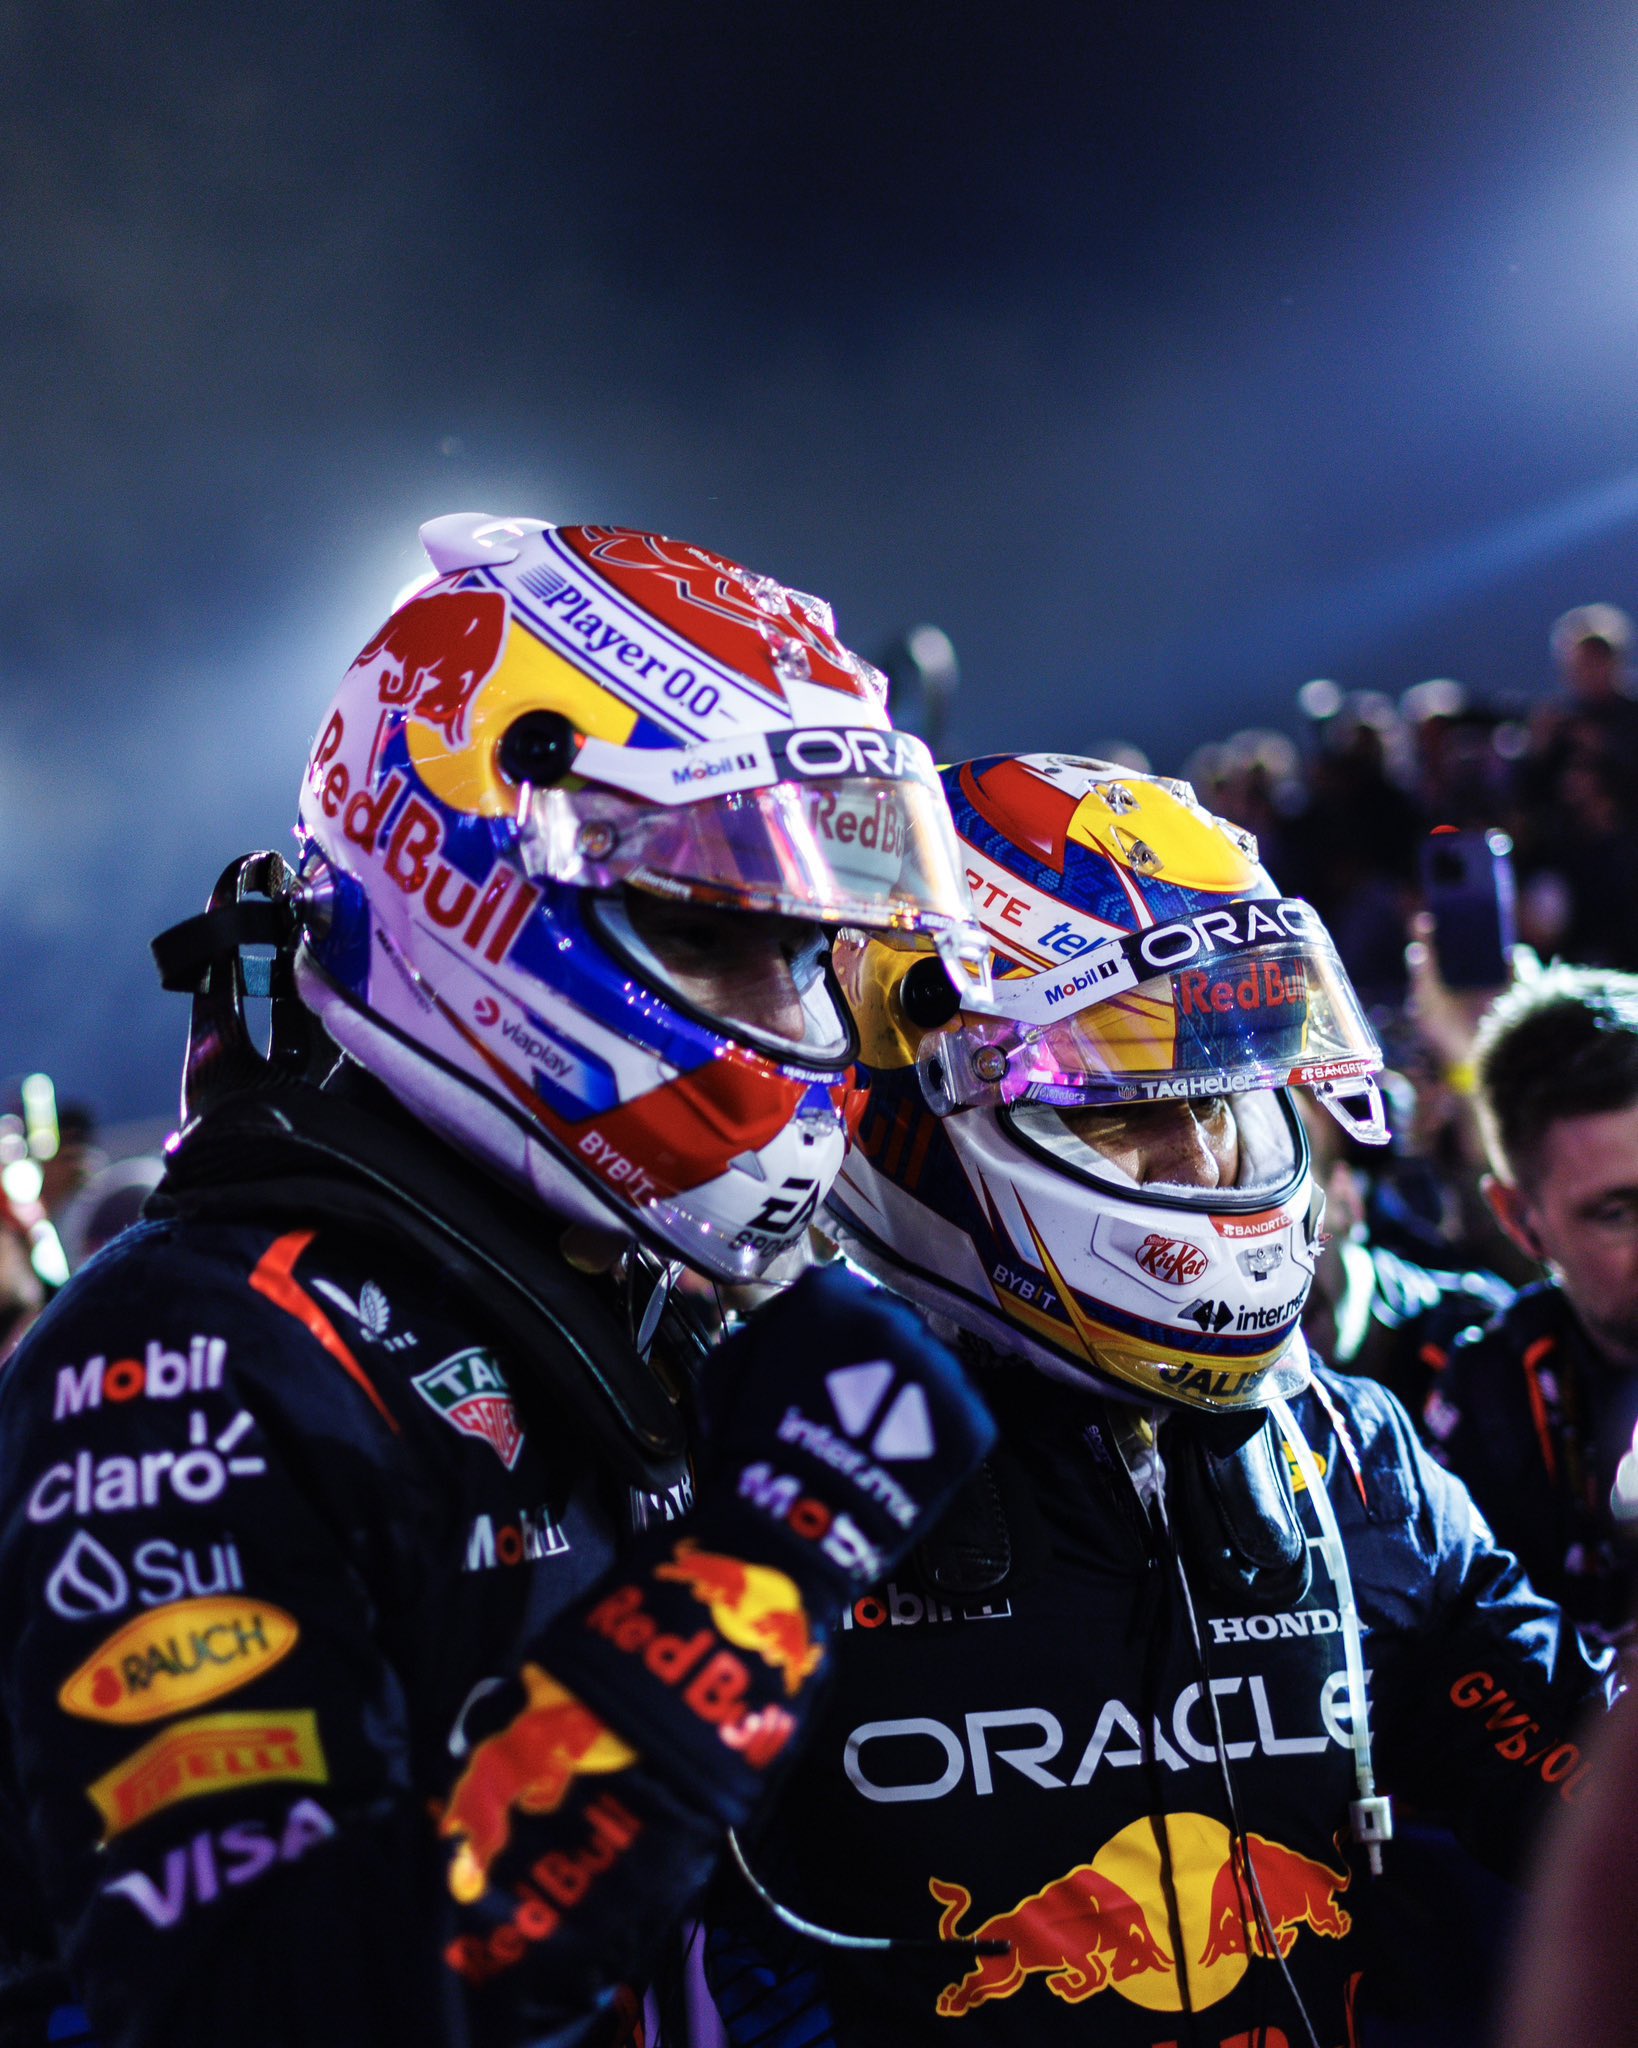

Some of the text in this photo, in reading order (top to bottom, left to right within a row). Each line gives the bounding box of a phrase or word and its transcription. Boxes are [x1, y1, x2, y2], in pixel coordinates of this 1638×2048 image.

[543, 585, 720, 717] Player 0.0
[672, 755, 734, 784] Mobil
[309, 708, 541, 965] Red Bull
[811, 791, 881, 849] Red
[1044, 968, 1099, 1005] Mobil
[1179, 959, 1307, 1015] Red Bull
[500, 1019, 574, 1078] viaplay
[578, 1130, 657, 1197] BYBIT
[1235, 1215, 1290, 1236] BANORTE
[992, 1263, 1057, 1310] BYBIT
[53, 1334, 227, 1421] Mobil
[27, 1448, 227, 1523] Claro
[133, 1532, 243, 1605] Sui
[121, 1614, 269, 1695] RAUCH
[843, 1670, 1374, 1802] ORACLE
[103, 1798, 336, 1929] VISA
